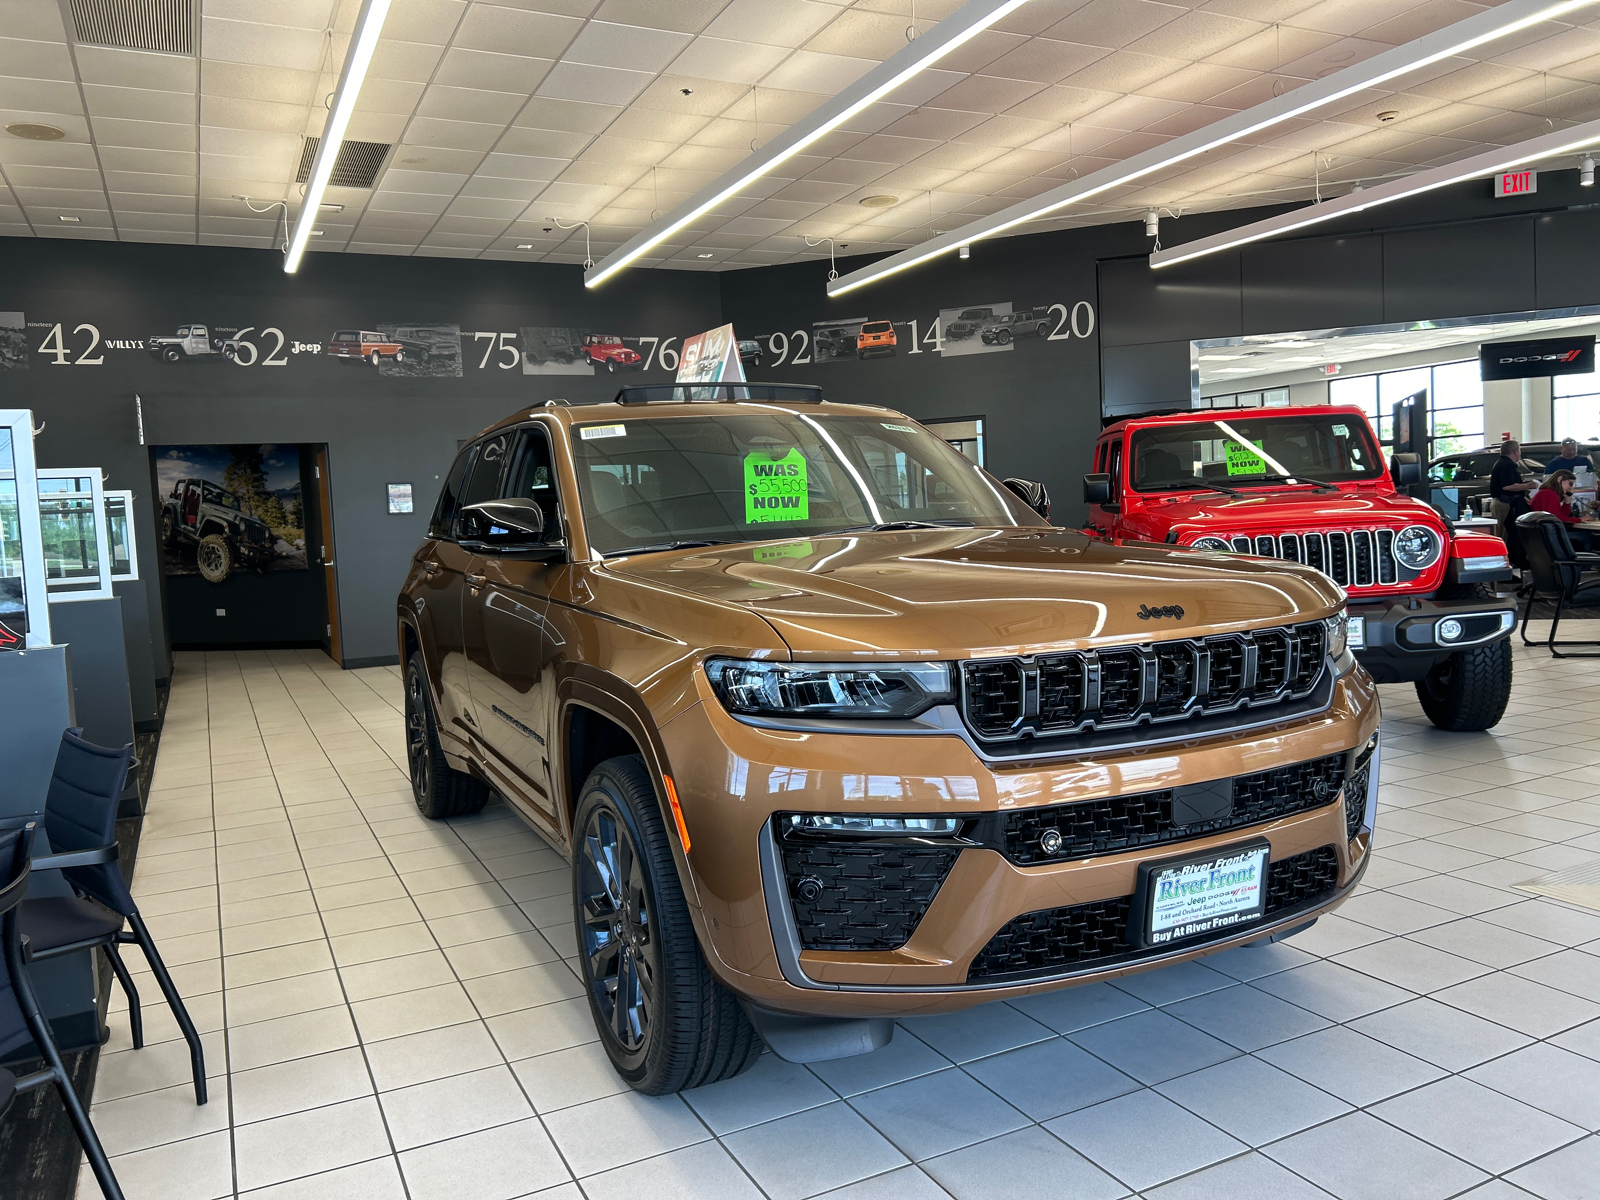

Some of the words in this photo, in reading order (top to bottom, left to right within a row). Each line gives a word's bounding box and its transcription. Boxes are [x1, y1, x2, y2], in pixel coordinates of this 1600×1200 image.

[1503, 172, 1531, 194] EXIT
[1046, 301, 1095, 341] 20
[37, 322, 105, 365] 42
[104, 339, 144, 349] WILLYS
[232, 326, 289, 367] 62
[907, 316, 946, 355] 14
[290, 341, 322, 354] Jeep
[474, 331, 520, 370] 75
[638, 336, 680, 371] 76
[768, 329, 812, 368] 92
[1499, 353, 1570, 364] DODGE
[753, 464, 799, 477] WAS
[1231, 459, 1260, 468] NOW
[753, 496, 801, 509] NOW
[1137, 603, 1185, 621] Jeep
[1181, 862, 1213, 876] River
[1214, 853, 1245, 869] Front
[1187, 896, 1206, 906] Jeep
[1172, 909, 1182, 918] and
[1152, 931, 1172, 943] Buy
[1173, 926, 1185, 938] At
[1185, 921, 1212, 935] River
